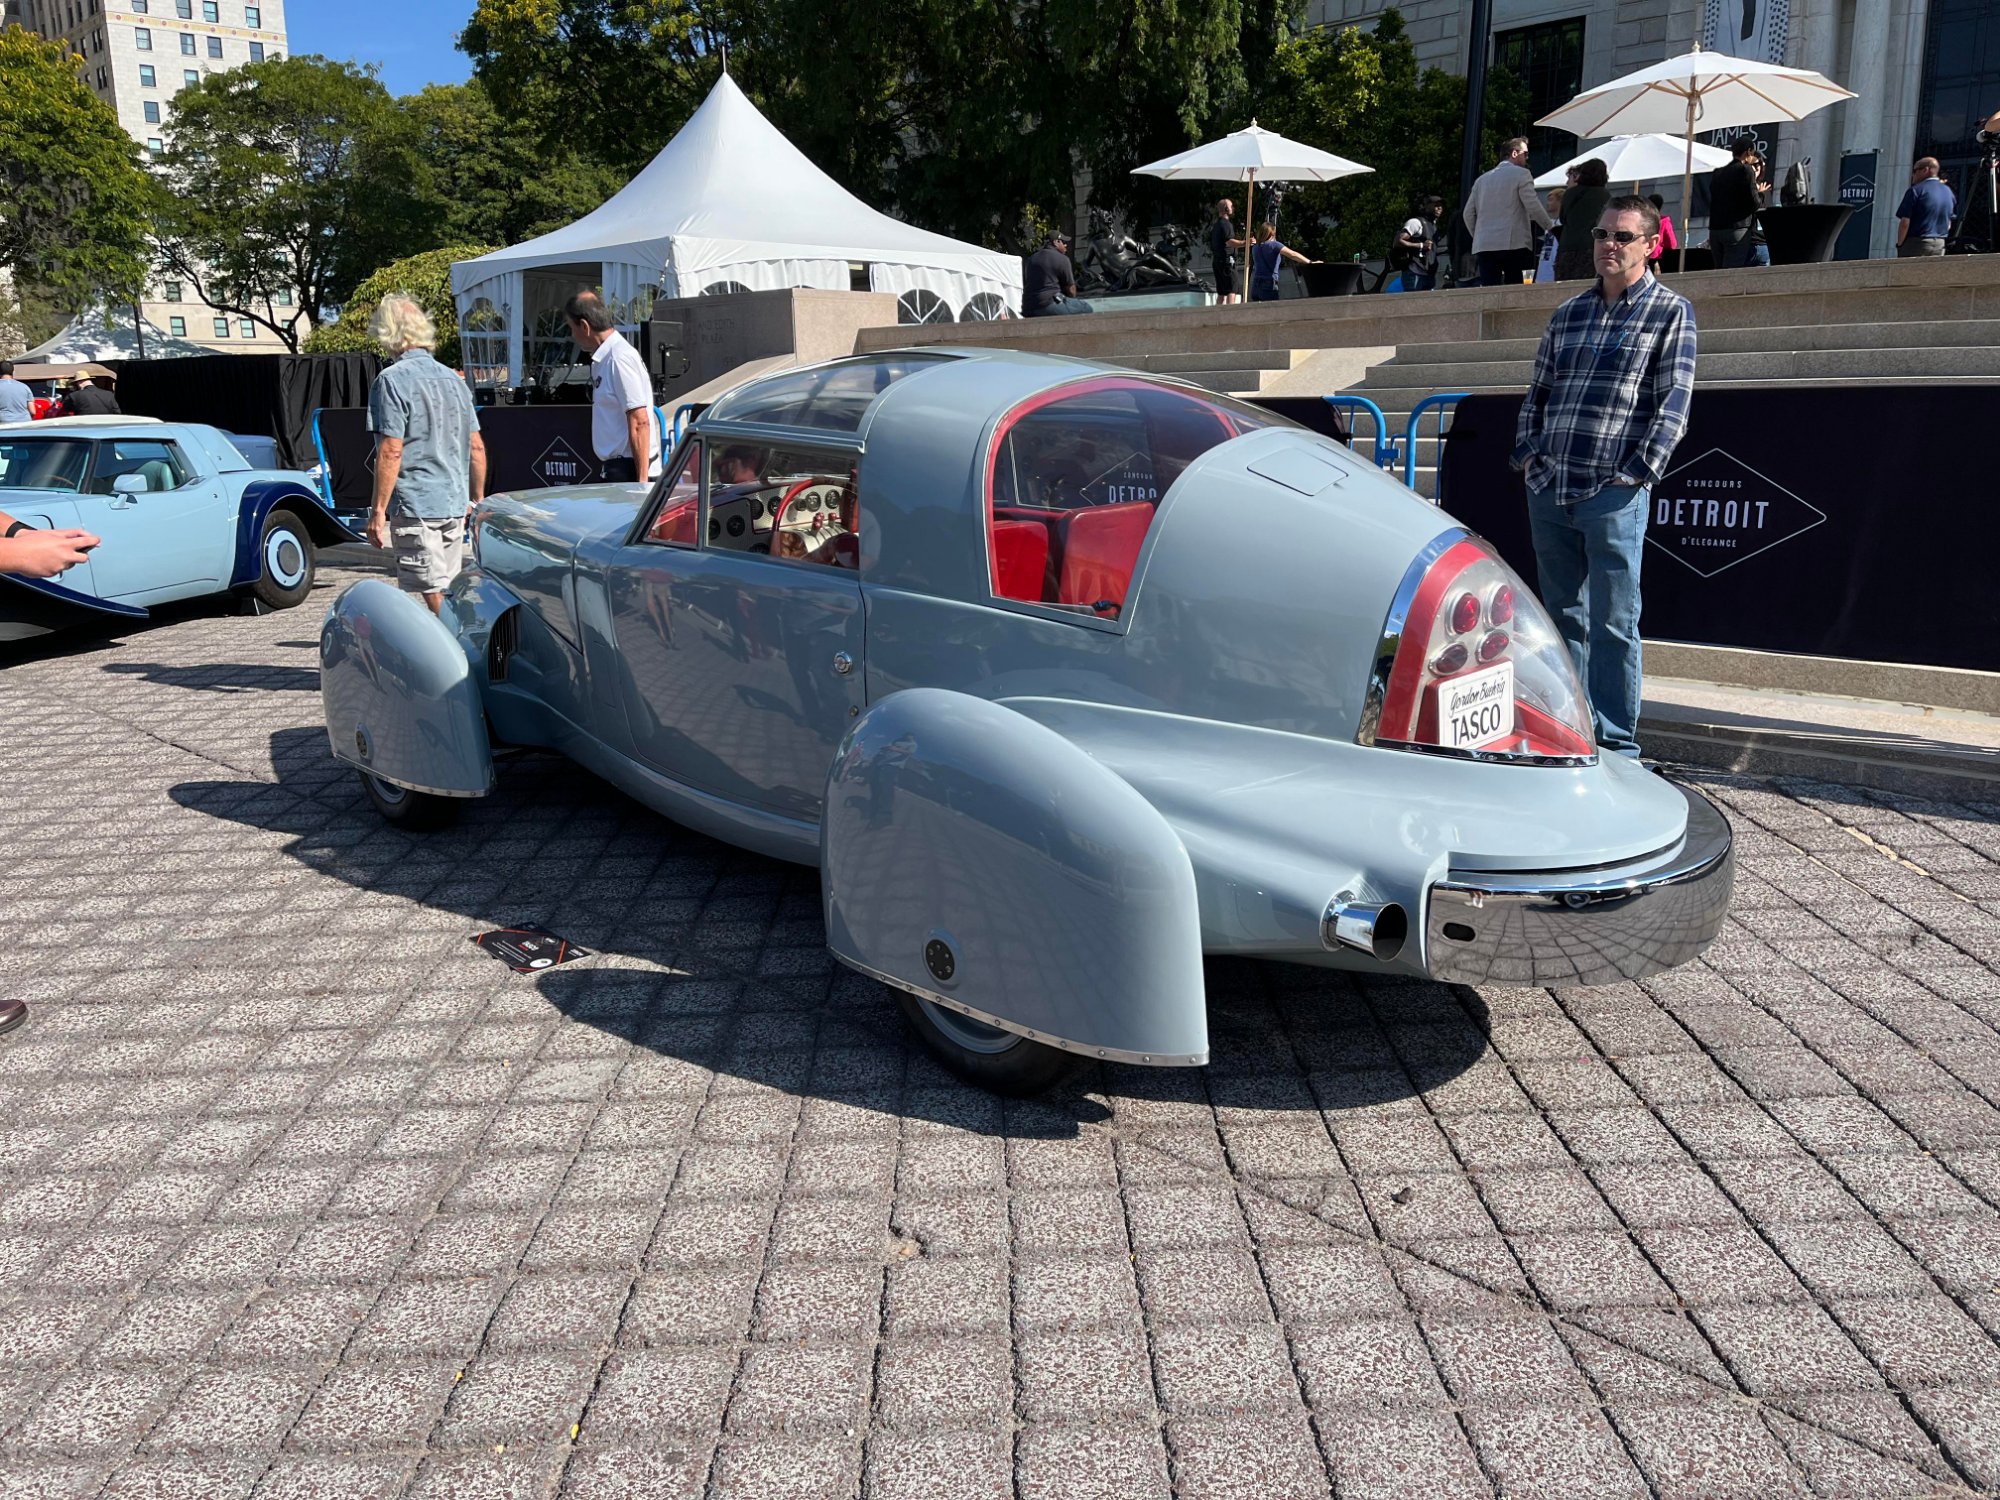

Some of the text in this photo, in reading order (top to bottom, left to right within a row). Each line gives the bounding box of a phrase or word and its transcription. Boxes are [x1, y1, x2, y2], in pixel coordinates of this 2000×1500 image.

[1842, 188, 1873, 198] DETROIT
[545, 461, 577, 477] DETROIT
[1686, 479, 1742, 489] CONCOURS
[1656, 498, 1769, 529] DETROIT
[1681, 536, 1737, 548] D'ELEGANCE
[1448, 686, 1479, 719] Gordon
[1451, 703, 1501, 746] TASCO
